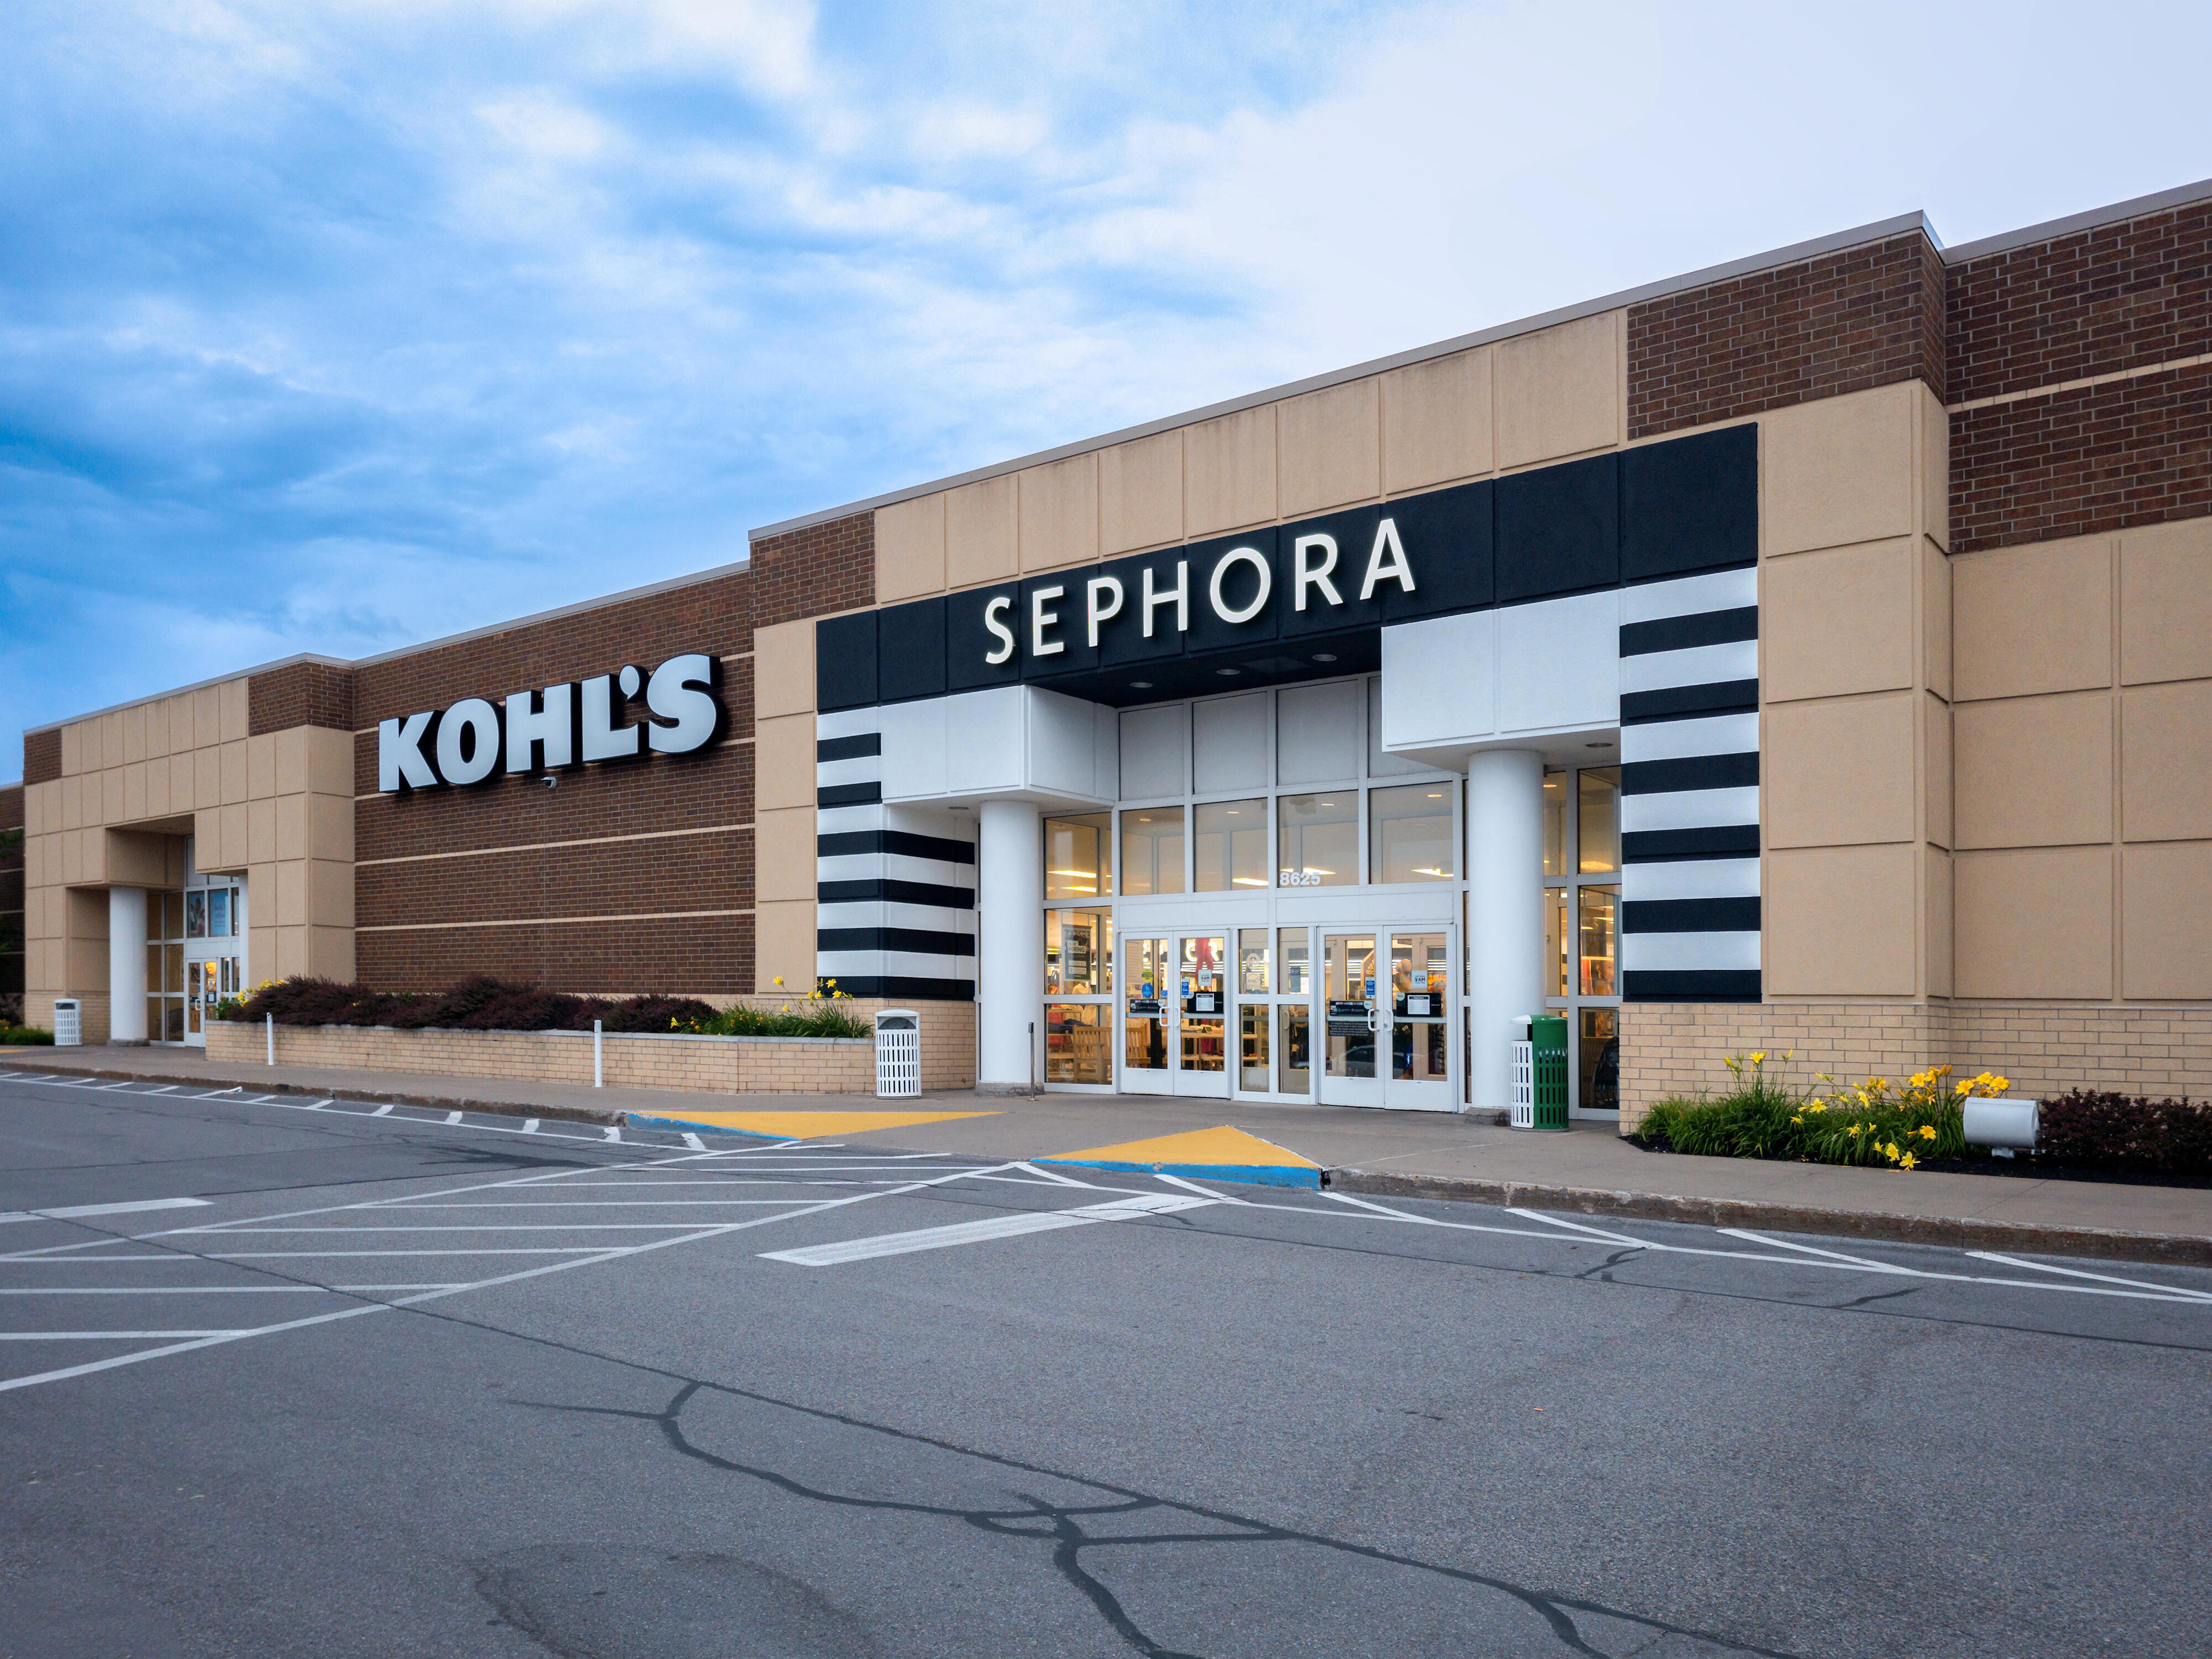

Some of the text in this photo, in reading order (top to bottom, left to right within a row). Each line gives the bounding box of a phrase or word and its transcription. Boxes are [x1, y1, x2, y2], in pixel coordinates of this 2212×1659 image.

[984, 518, 1416, 664] SEPHORA
[378, 653, 720, 793] KOHL'S
[1279, 871, 1321, 886] 8625
